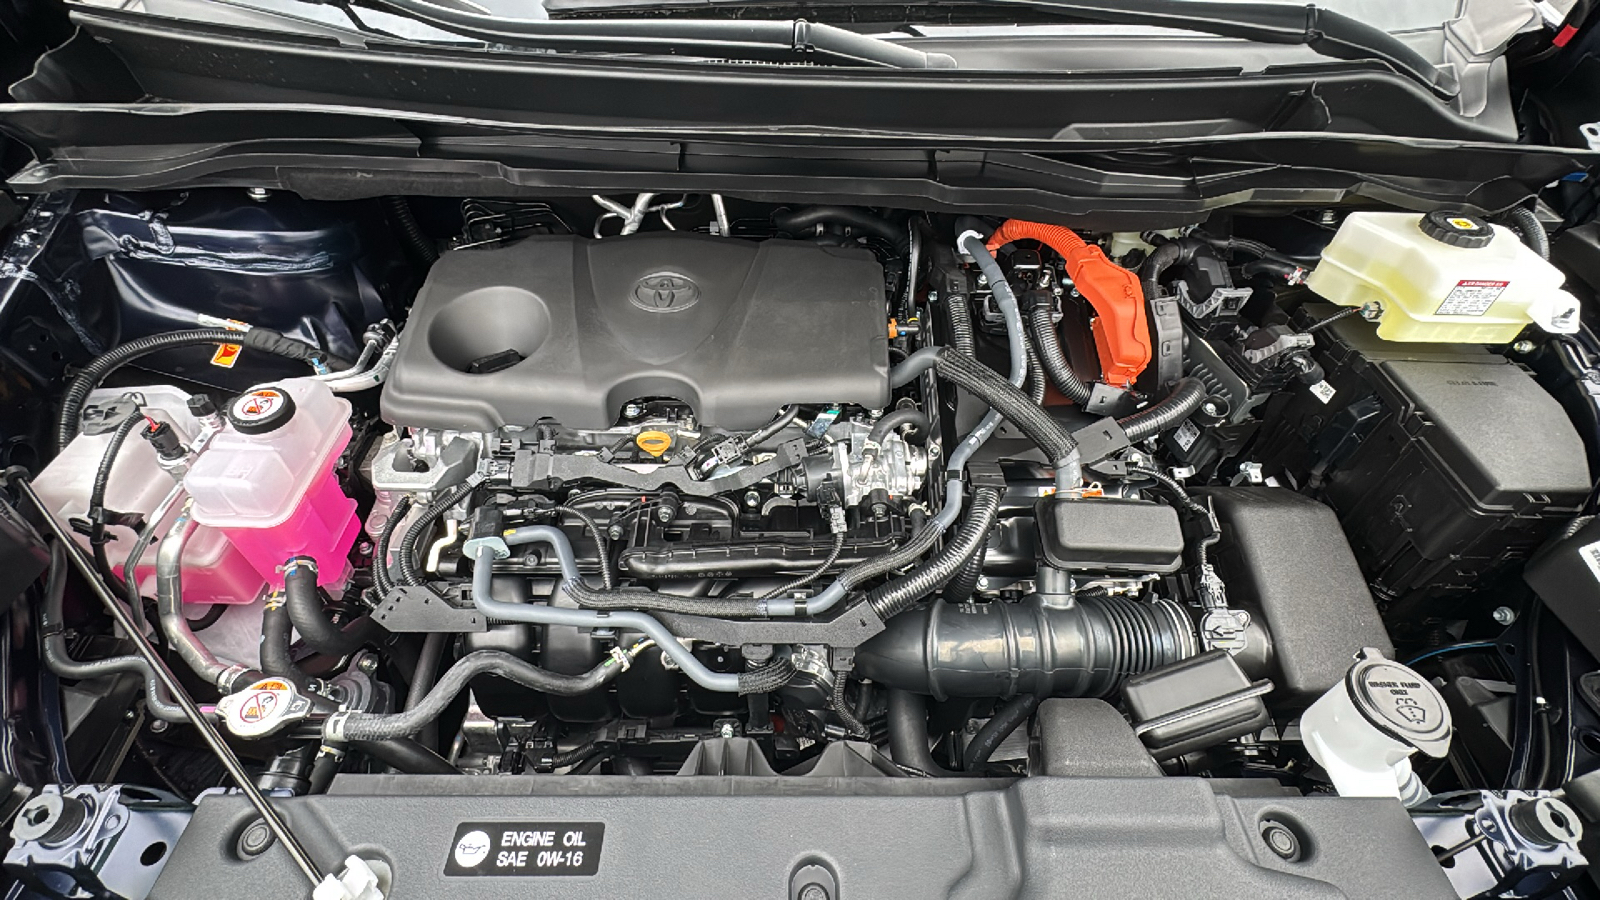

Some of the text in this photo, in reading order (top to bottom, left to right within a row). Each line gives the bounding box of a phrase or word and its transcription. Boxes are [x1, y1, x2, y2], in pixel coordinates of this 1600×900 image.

[501, 831, 587, 847] ENGINE OIL
[496, 851, 584, 867] SAE 0W-16
